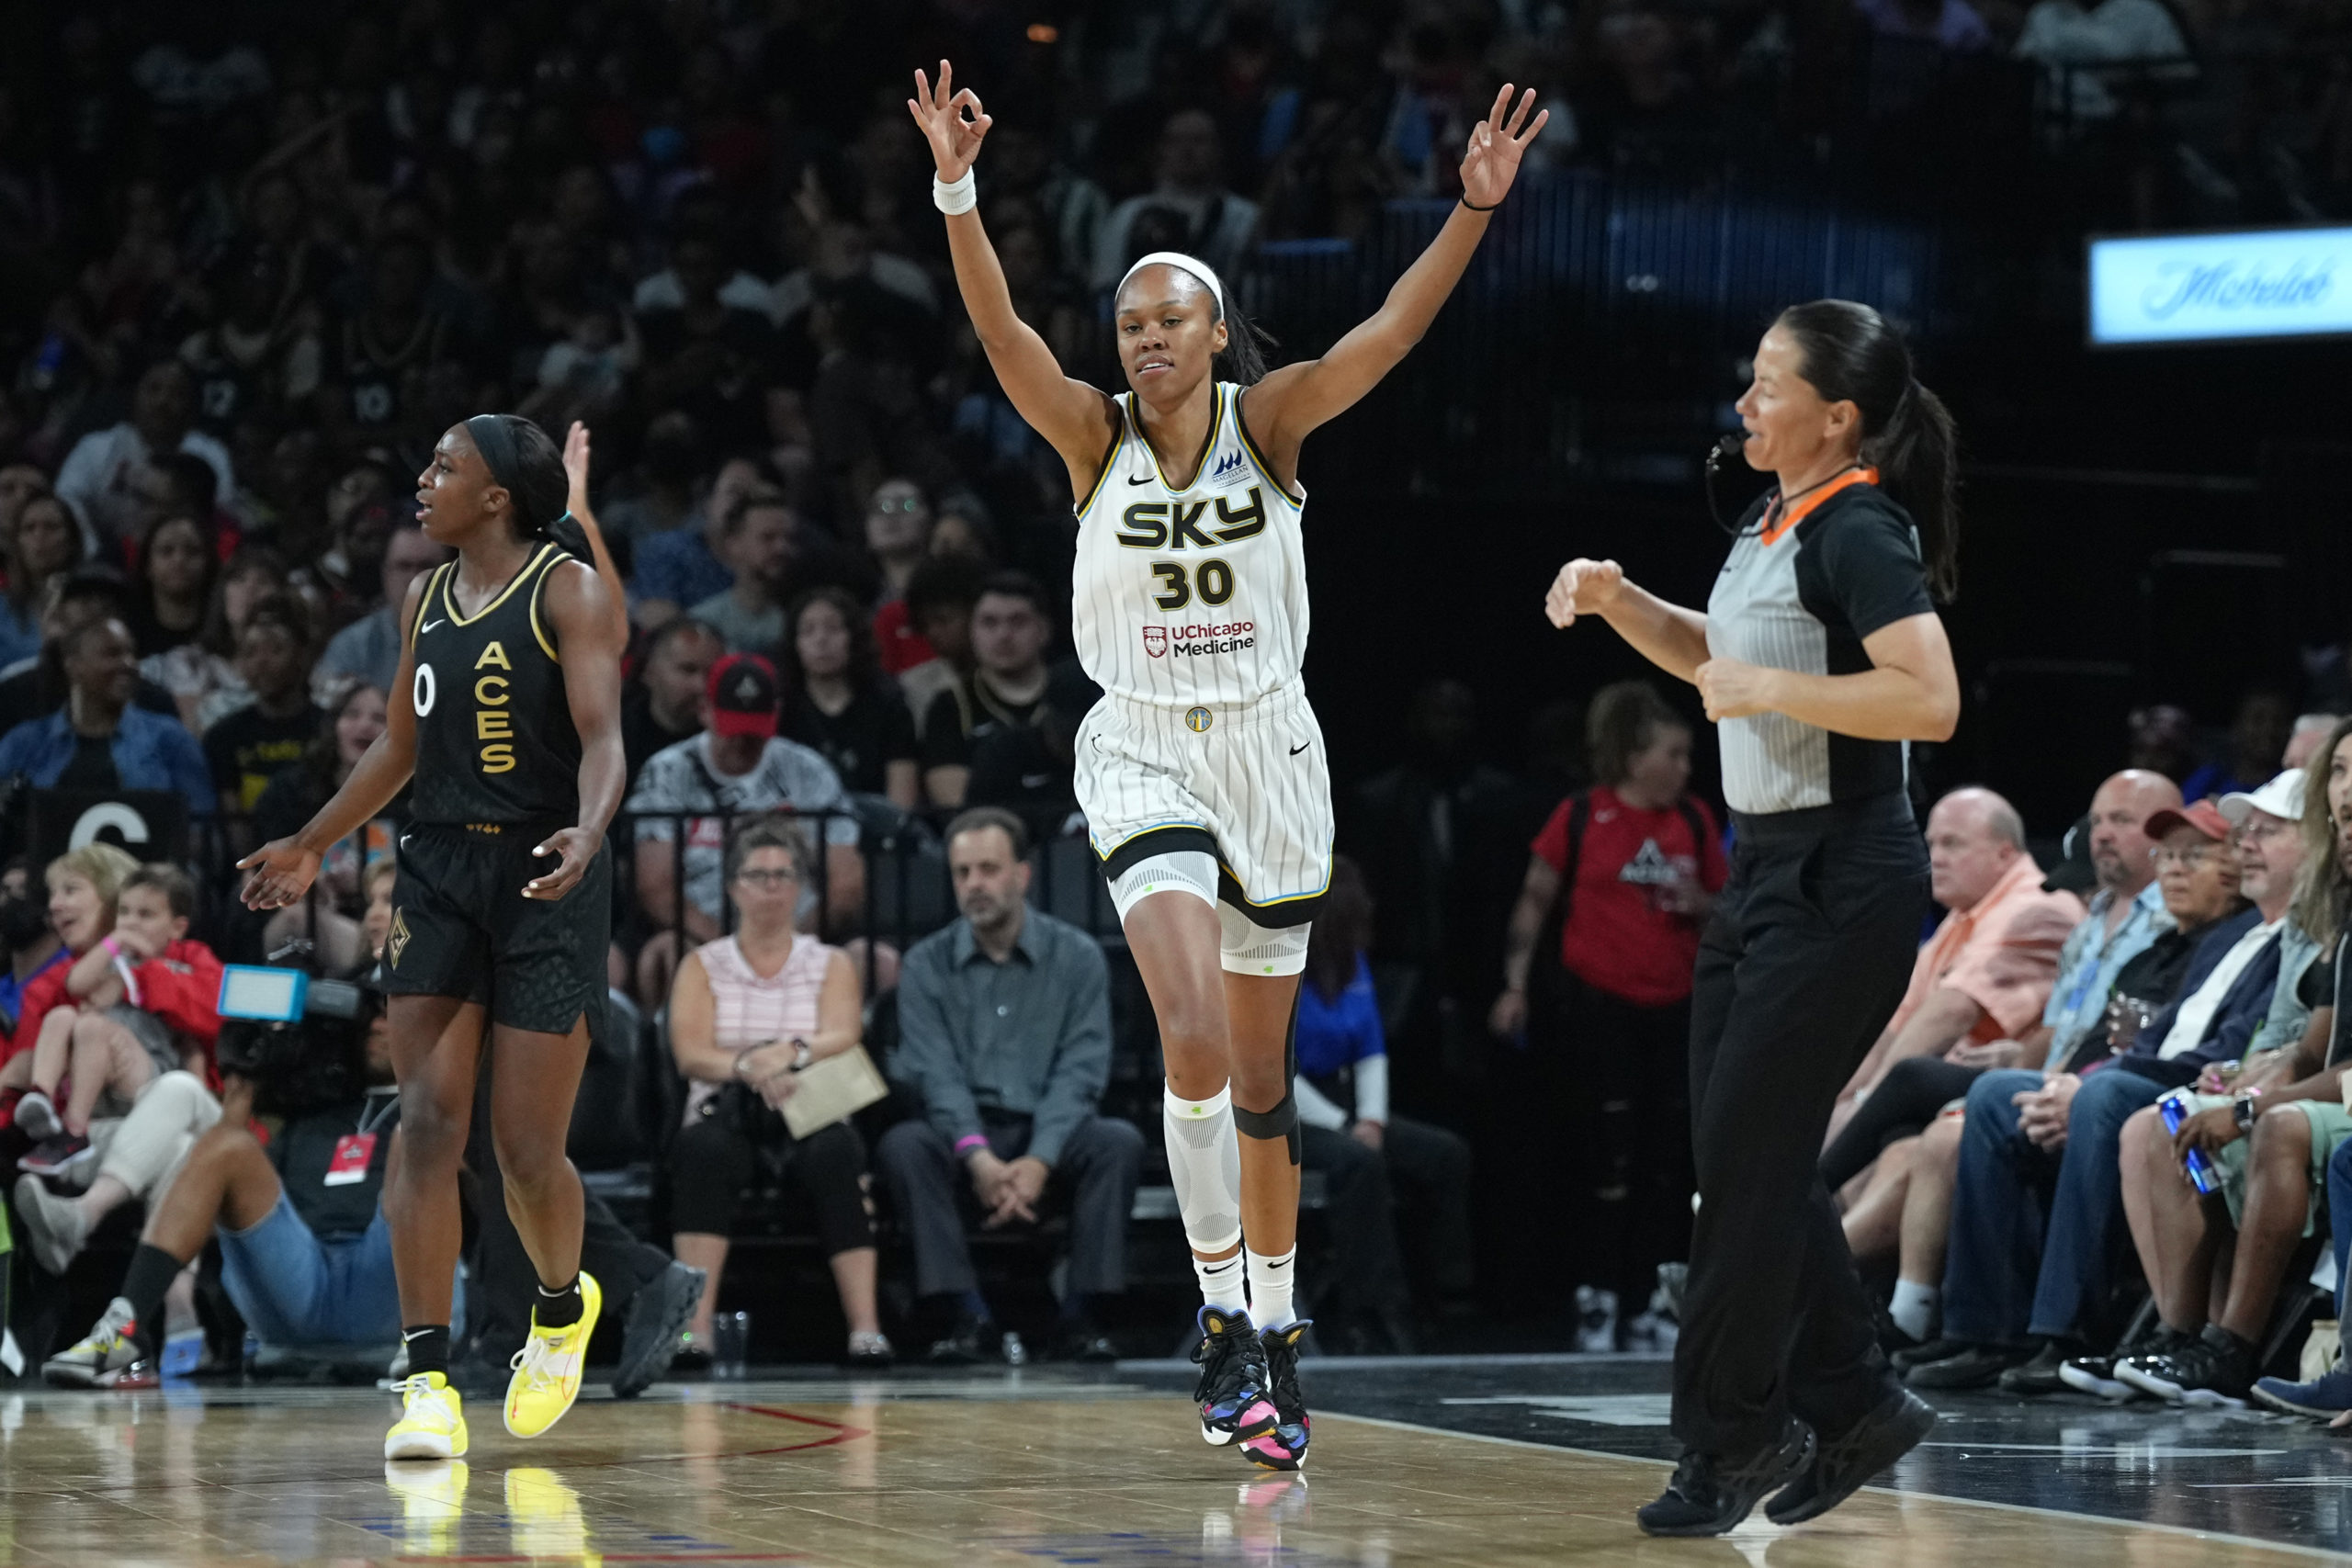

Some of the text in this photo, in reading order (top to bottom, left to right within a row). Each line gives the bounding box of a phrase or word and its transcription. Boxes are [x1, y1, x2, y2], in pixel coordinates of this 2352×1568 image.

[1212, 465, 1250, 483] MAGELLAN
[1115, 486, 1267, 551] SKY
[1150, 558, 1235, 612] 30
[1171, 621, 1254, 640] UChicago
[1173, 637, 1254, 658] Medicine
[413, 662, 435, 717] 0
[474, 641, 516, 773] ACES
